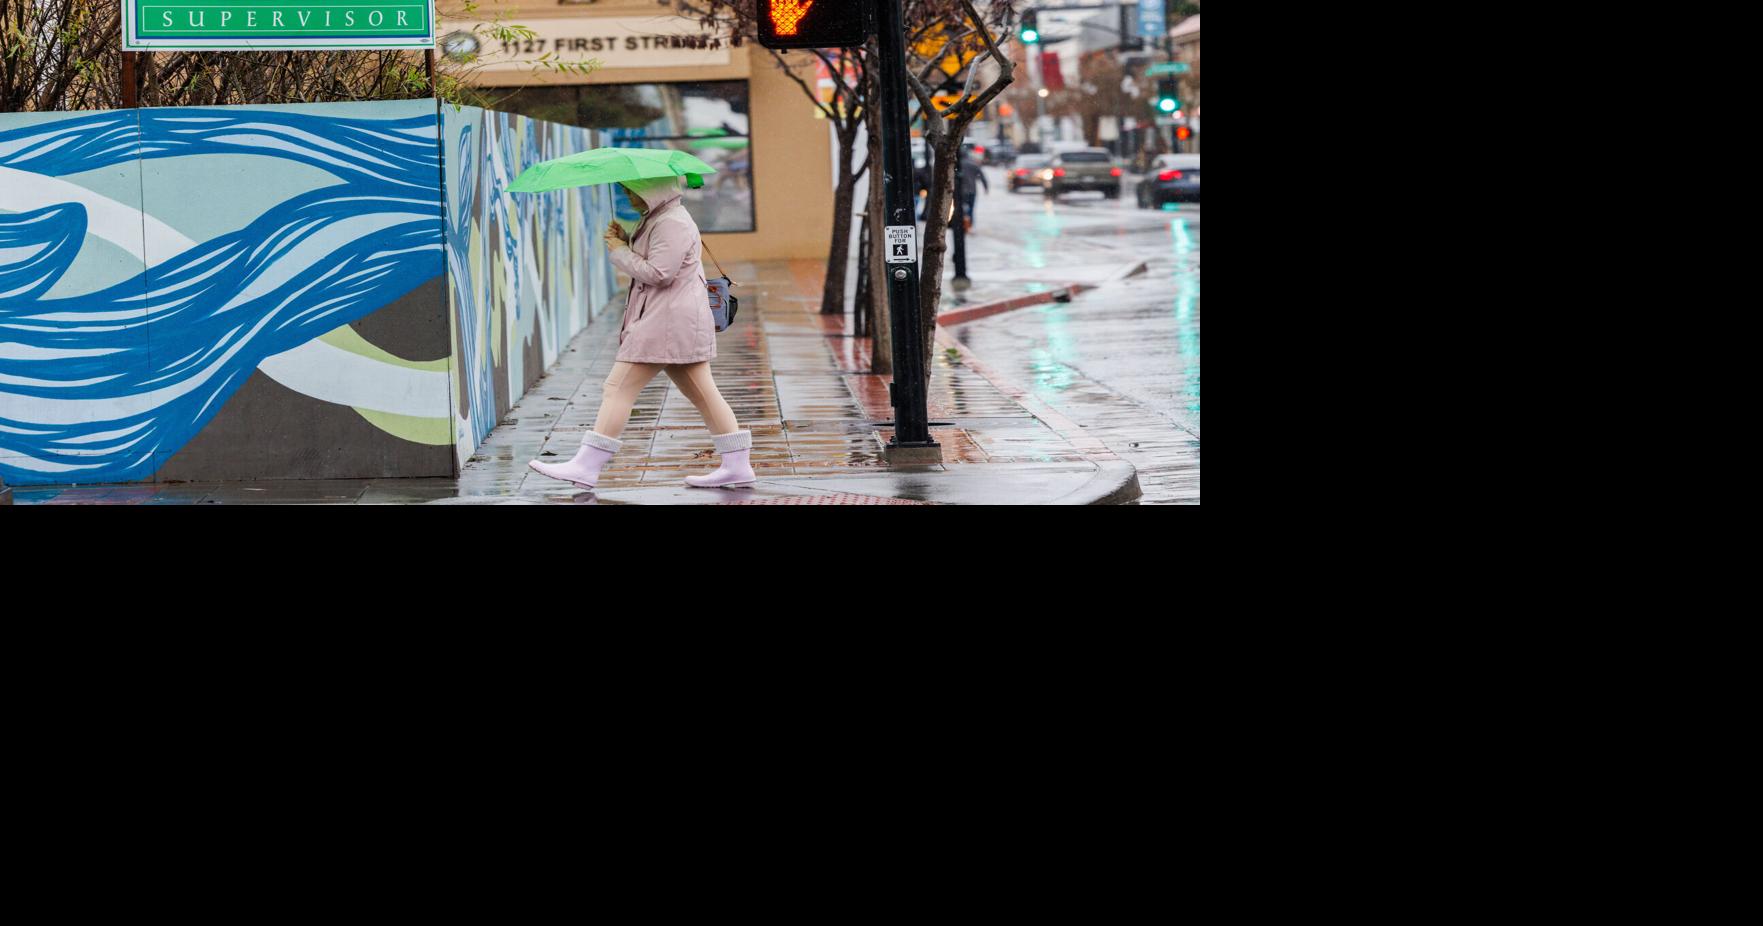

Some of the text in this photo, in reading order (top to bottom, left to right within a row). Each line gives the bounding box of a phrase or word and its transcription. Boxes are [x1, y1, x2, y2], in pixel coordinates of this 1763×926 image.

[162, 10, 408, 27] SUPERVISOR
[501, 39, 546, 53] 1127
[554, 36, 616, 51] FIRST
